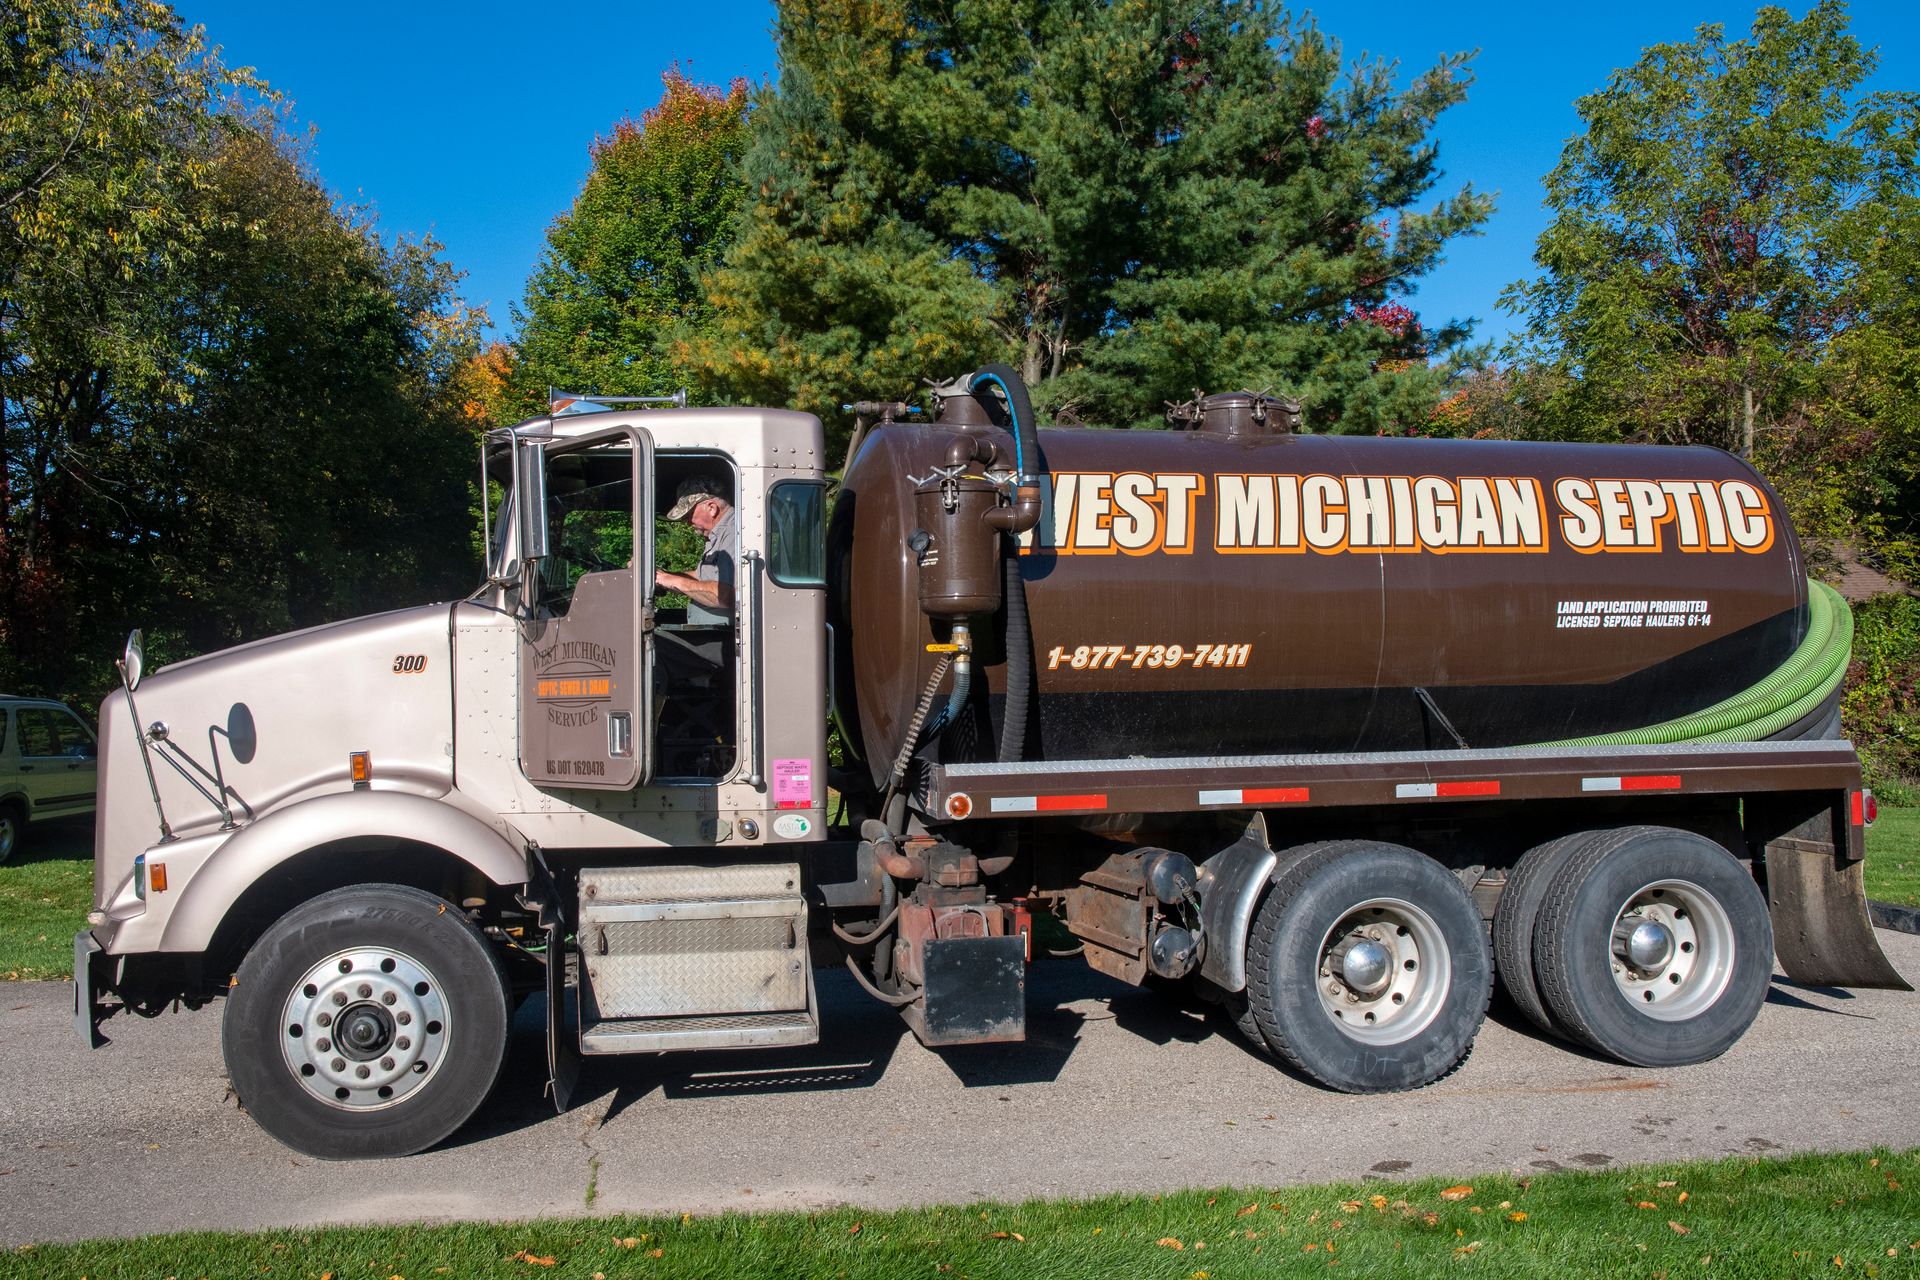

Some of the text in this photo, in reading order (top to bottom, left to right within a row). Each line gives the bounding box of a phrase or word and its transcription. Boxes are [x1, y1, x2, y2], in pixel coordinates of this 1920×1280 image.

[1213, 474, 1549, 555] MICHIGAN
[1553, 477, 1775, 554] SEPTIC
[1557, 600, 1708, 614] LAND APPLICATION PROHIBITED
[1556, 614, 1712, 628] LICENSED SEPTAGE HAULERS 61-14
[392, 654, 428, 674] 300
[532, 641, 617, 671] WEST MICHIGAN
[1047, 643, 1252, 670] 1-877-739-7411
[538, 681, 558, 697] SEPTIC
[559, 680, 581, 696] SEWER
[588, 679, 609, 695] DRAIN
[547, 706, 599, 727] SERVICE
[546, 759, 605, 776] US DOT 1620478
